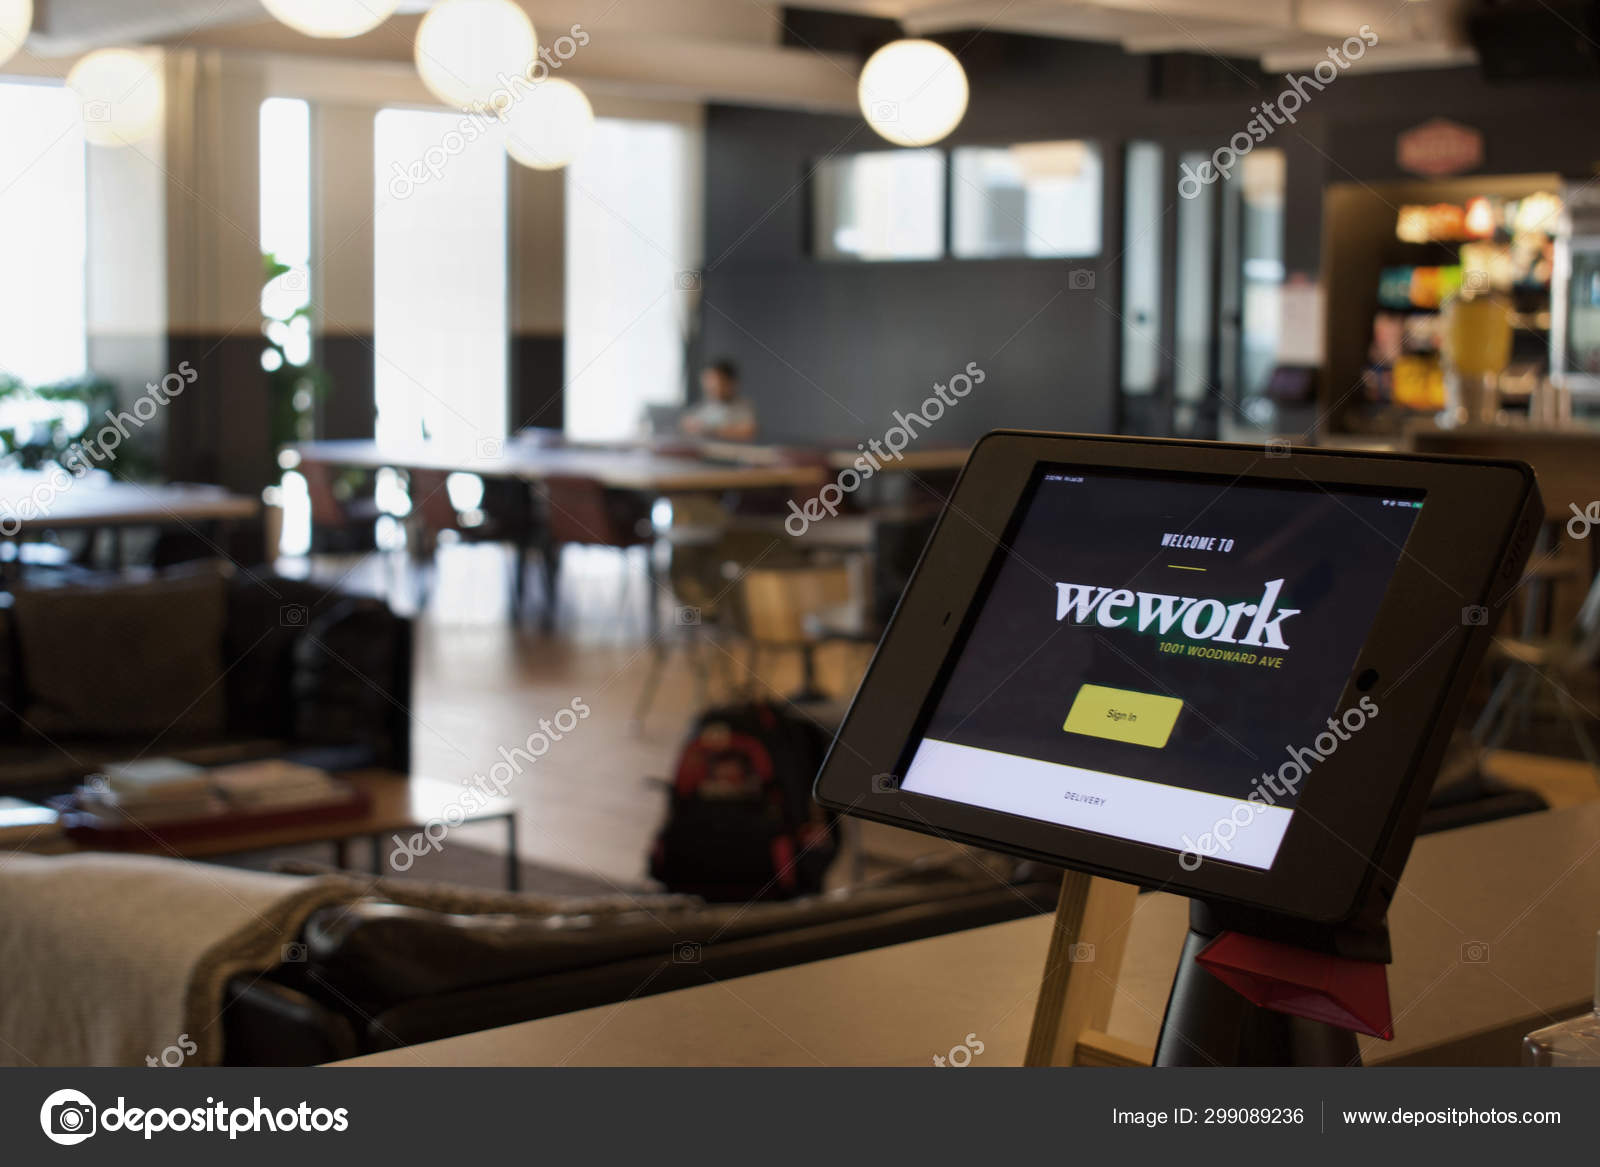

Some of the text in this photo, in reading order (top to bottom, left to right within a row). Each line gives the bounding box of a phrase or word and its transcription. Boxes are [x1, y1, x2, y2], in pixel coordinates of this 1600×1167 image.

[1161, 533, 1235, 552] WELCOME TO
[1055, 578, 1301, 650] wework
[1160, 642, 1284, 669] 1001 WOODWARD AVE
[1106, 708, 1127, 722] Sign
[1064, 791, 1107, 807] DELIVERY
